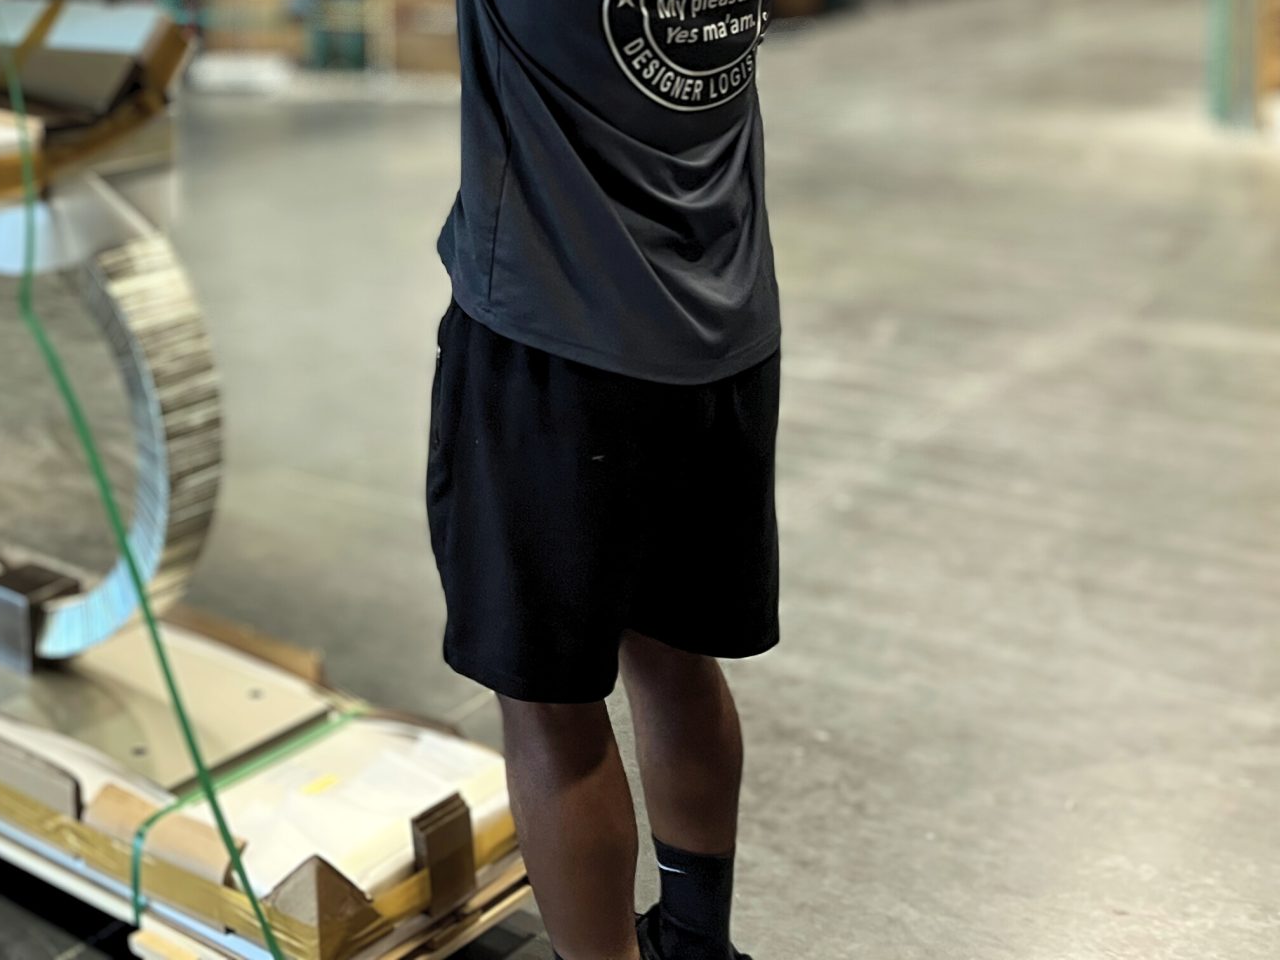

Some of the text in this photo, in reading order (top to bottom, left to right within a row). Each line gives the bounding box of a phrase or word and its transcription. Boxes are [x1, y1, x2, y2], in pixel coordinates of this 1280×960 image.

[665, 26, 698, 45] Yes
[623, 37, 756, 101] DESIGNER LOGIS
